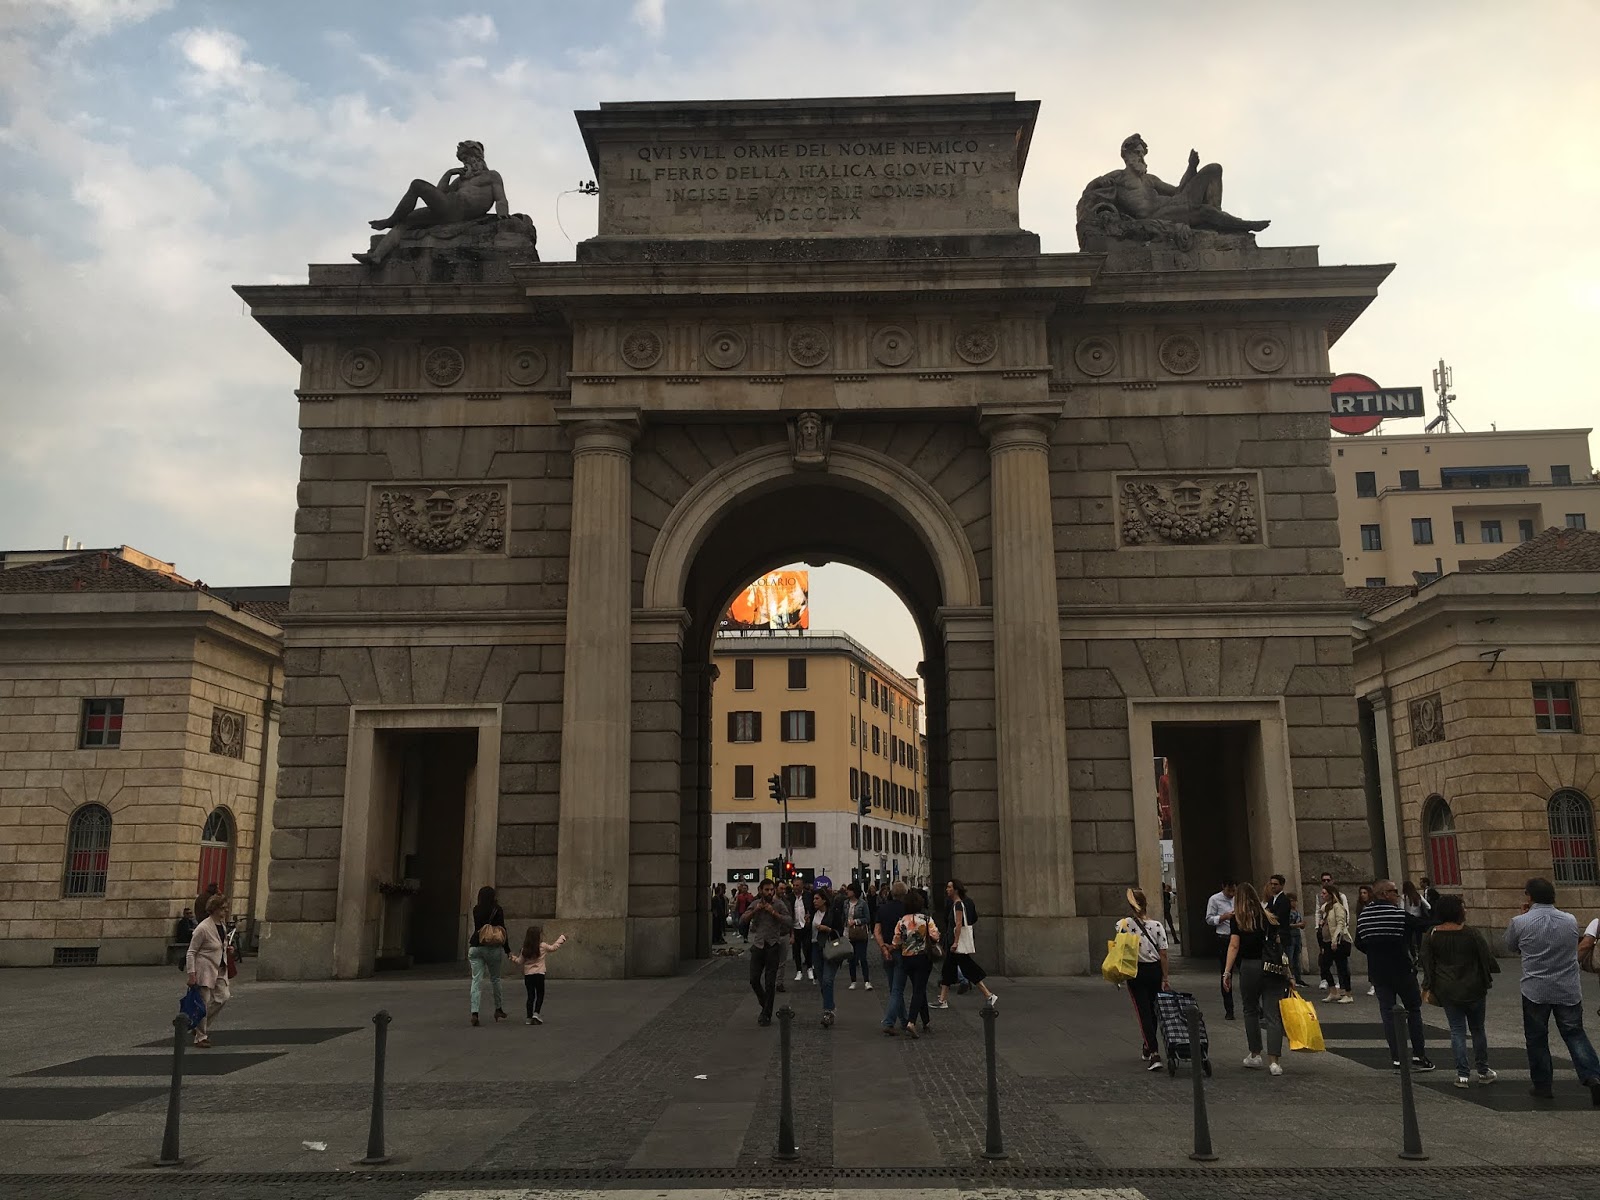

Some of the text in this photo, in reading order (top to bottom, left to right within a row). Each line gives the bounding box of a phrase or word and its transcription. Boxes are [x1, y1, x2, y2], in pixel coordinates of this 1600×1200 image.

[638, 140, 979, 162] QVI SVLL ORME DEL NOME NEMICO
[630, 161, 985, 182] IL FERRO DELLA ITALICA GIOVENTV
[666, 183, 956, 202] INCISE LE VITTORIE COMENSI
[756, 206, 862, 222] MDCCCLIX
[1331, 393, 1415, 413] RTINI
